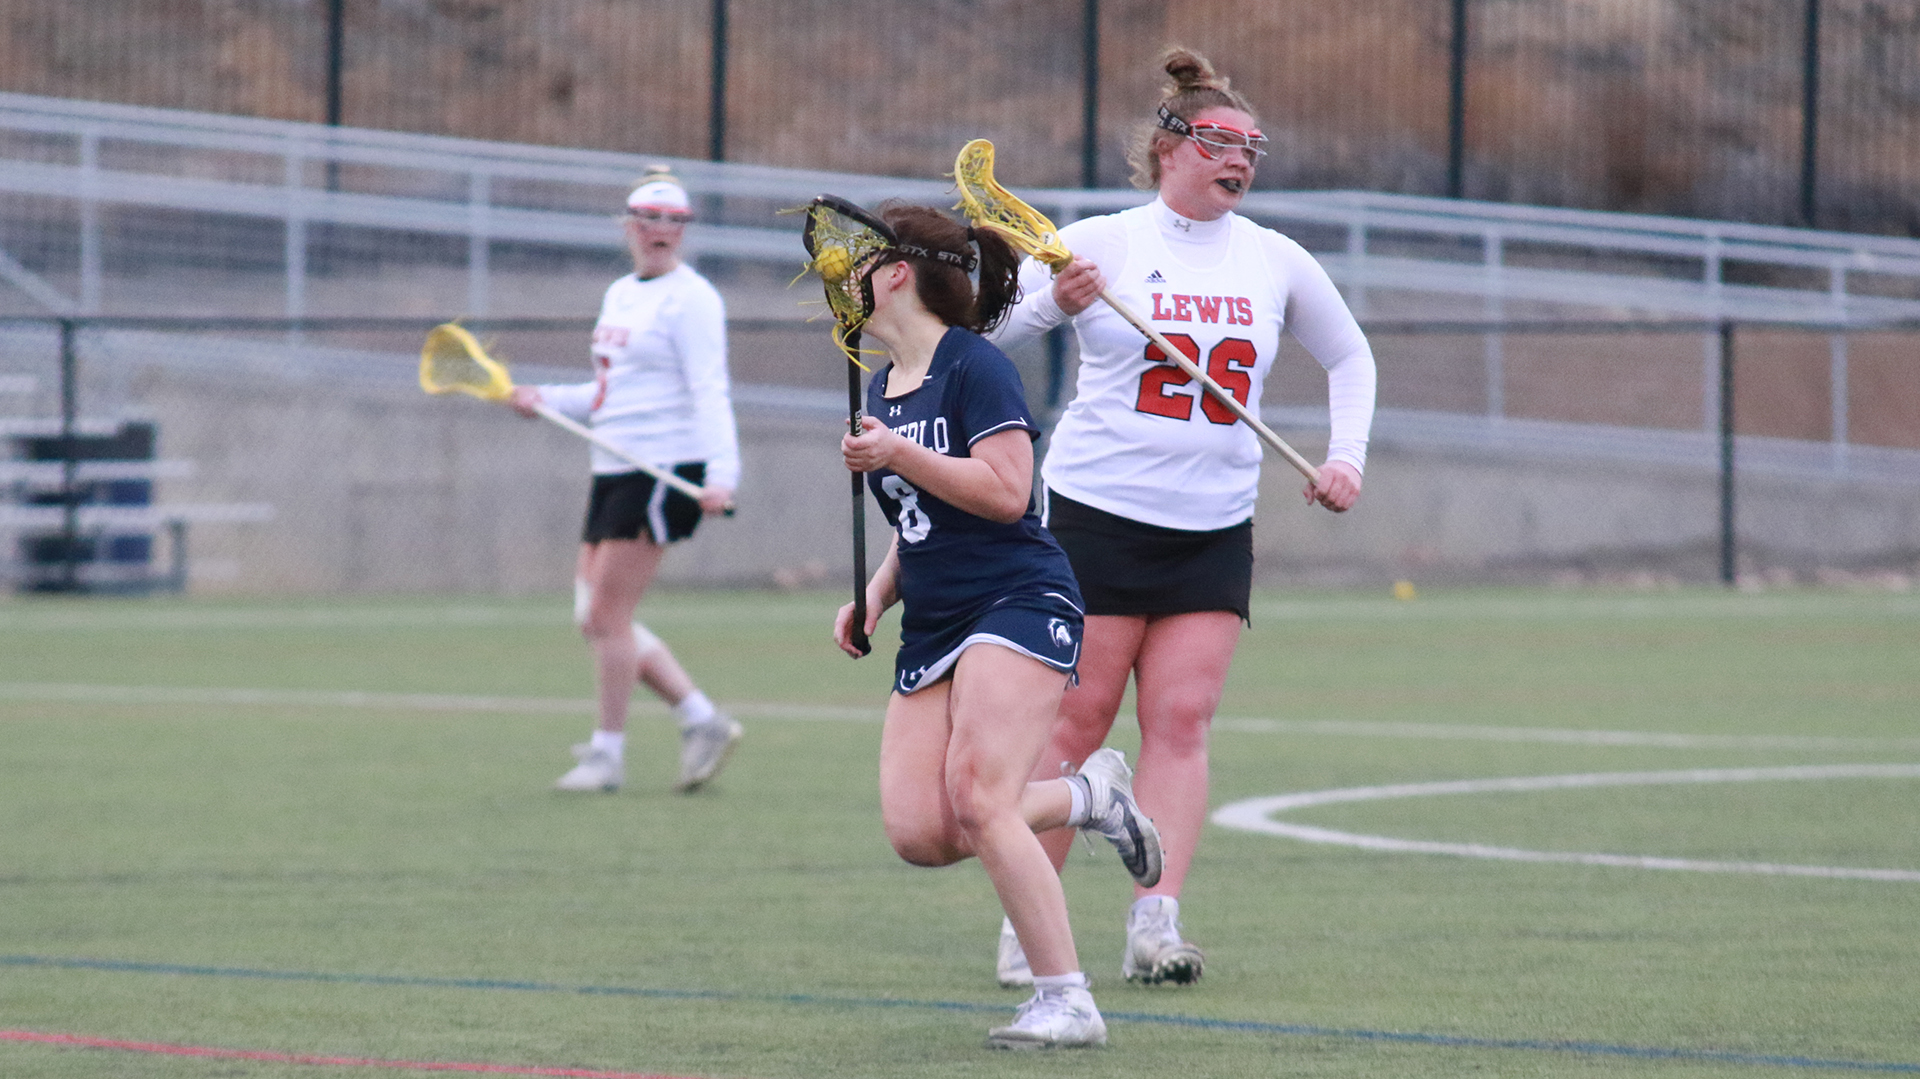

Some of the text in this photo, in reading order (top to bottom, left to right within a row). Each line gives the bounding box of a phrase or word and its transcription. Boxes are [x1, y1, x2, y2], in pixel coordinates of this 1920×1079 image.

[900, 243, 928, 258] STX
[938, 250, 962, 265] STX
[1151, 292, 1253, 326] LEWIS
[1135, 332, 1257, 426] 26
[881, 474, 932, 544] 8
